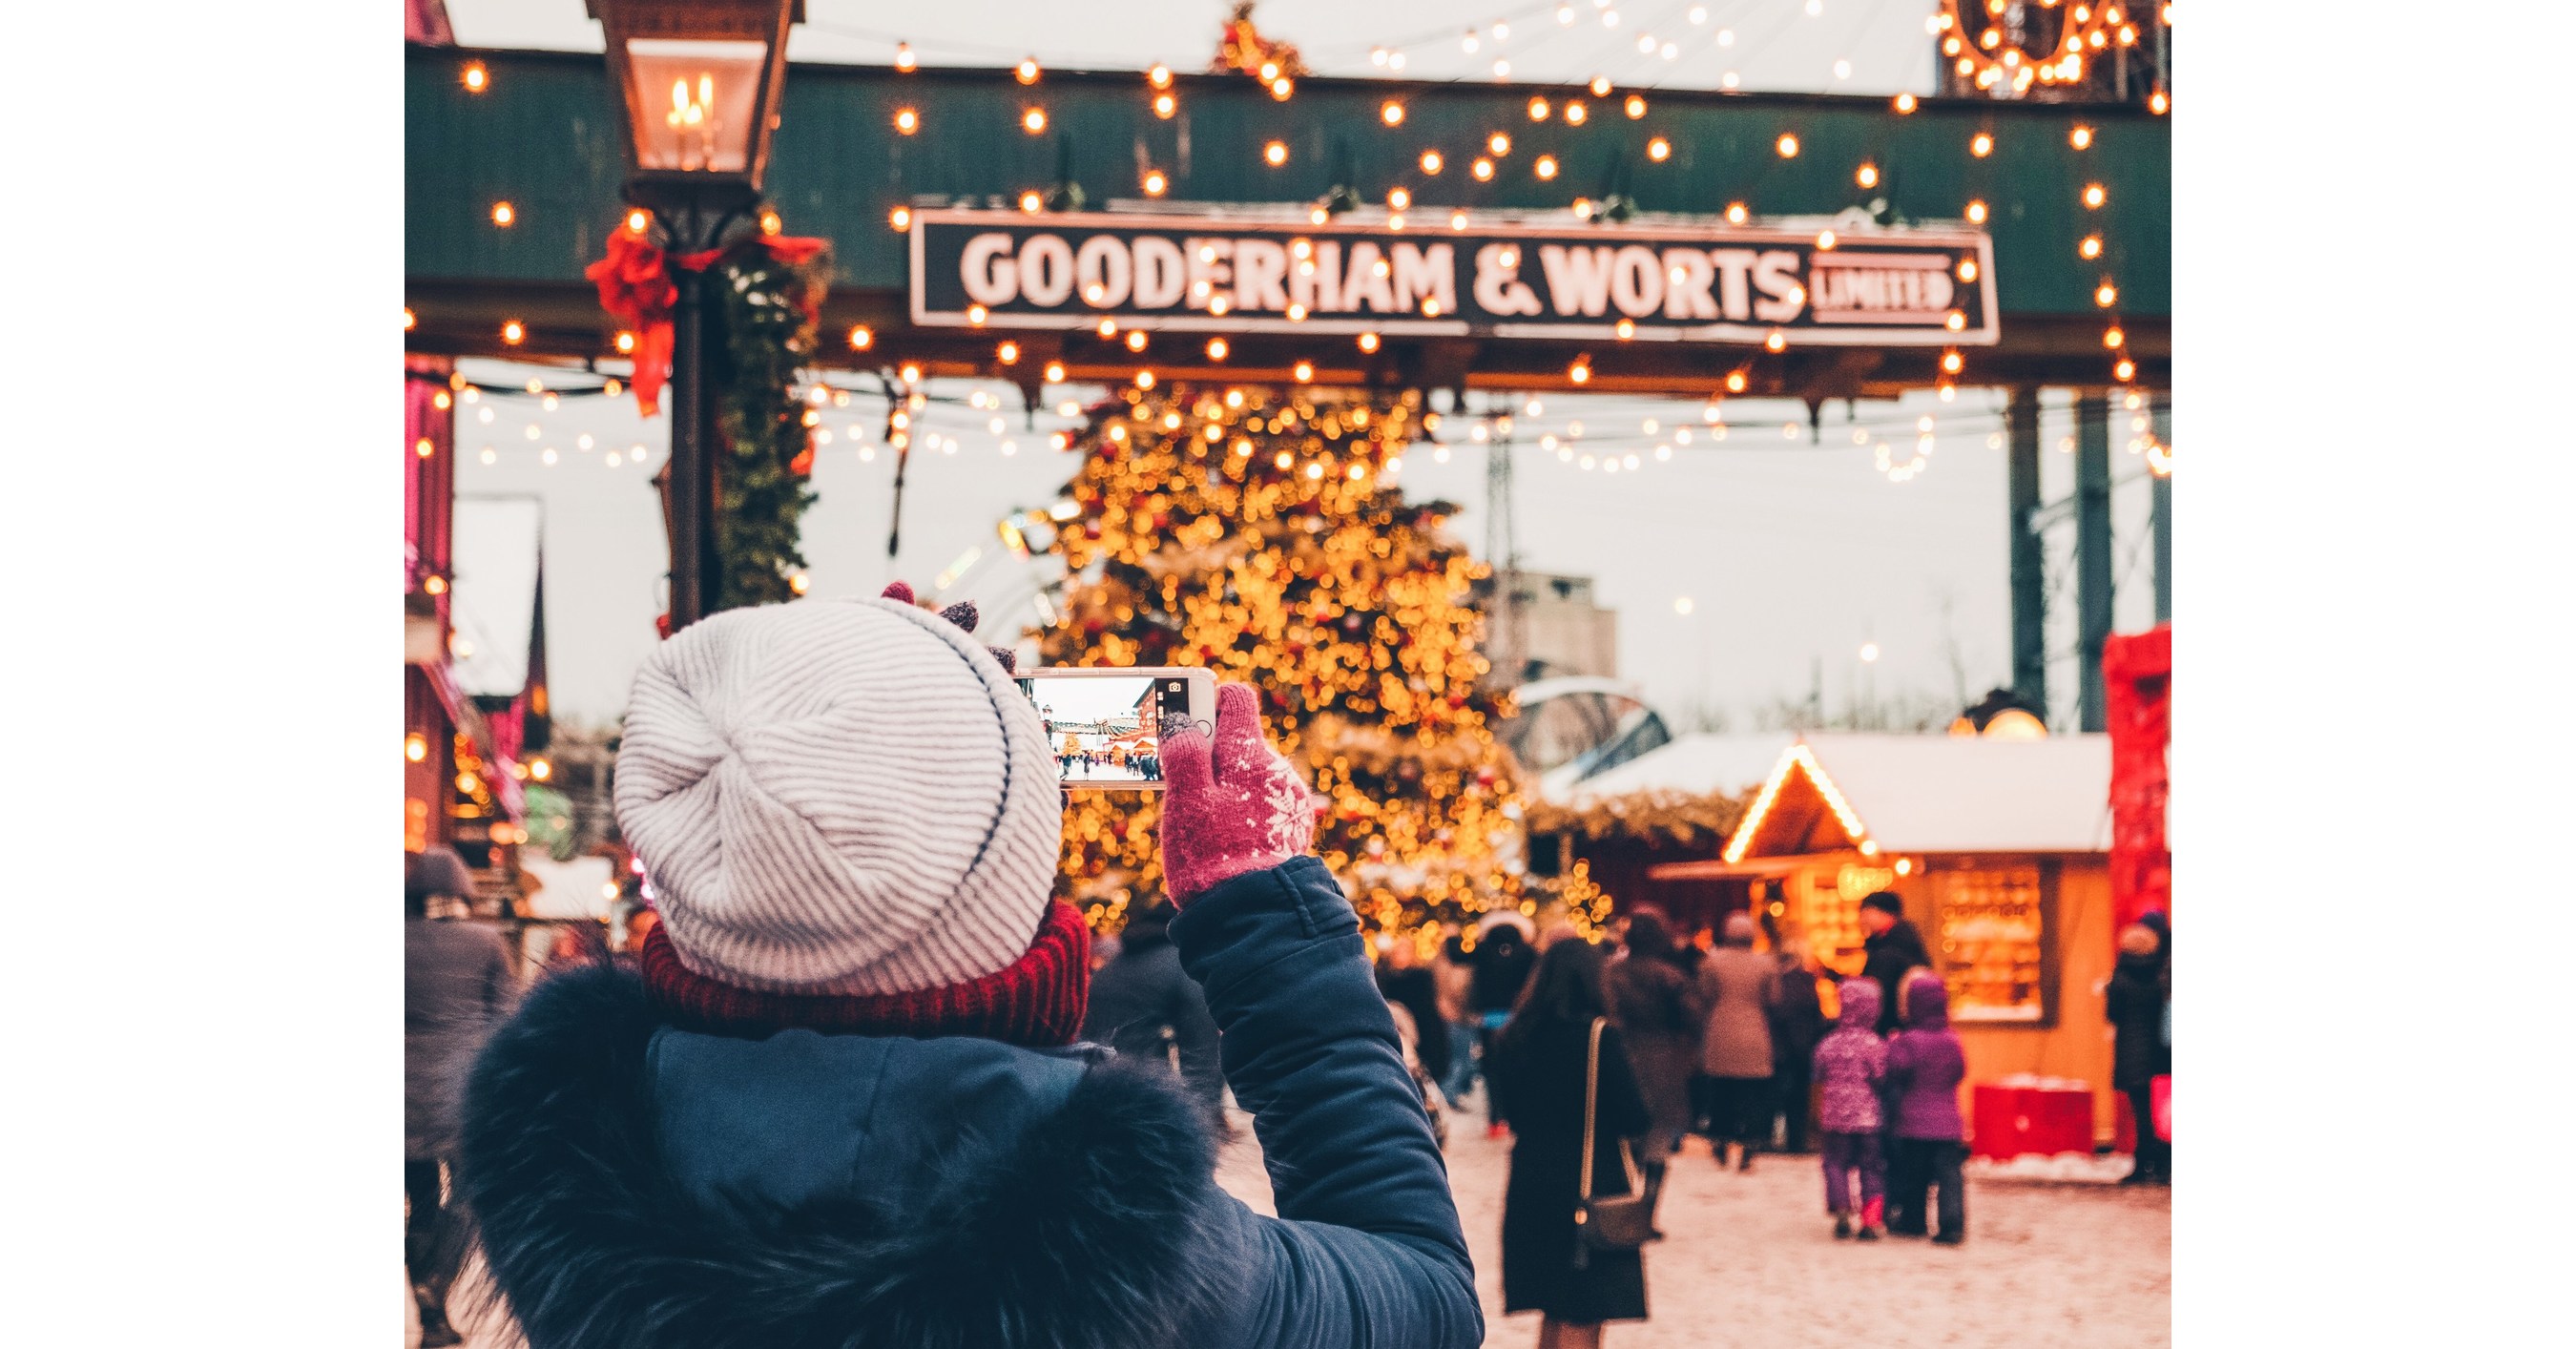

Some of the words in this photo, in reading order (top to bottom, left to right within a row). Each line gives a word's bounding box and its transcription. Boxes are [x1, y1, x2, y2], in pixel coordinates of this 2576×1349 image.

[960, 233, 1458, 313] GOODERHAM
[1474, 242, 1543, 317] &
[1540, 244, 1807, 322] WORTS
[1810, 268, 1954, 311] LIMITED
